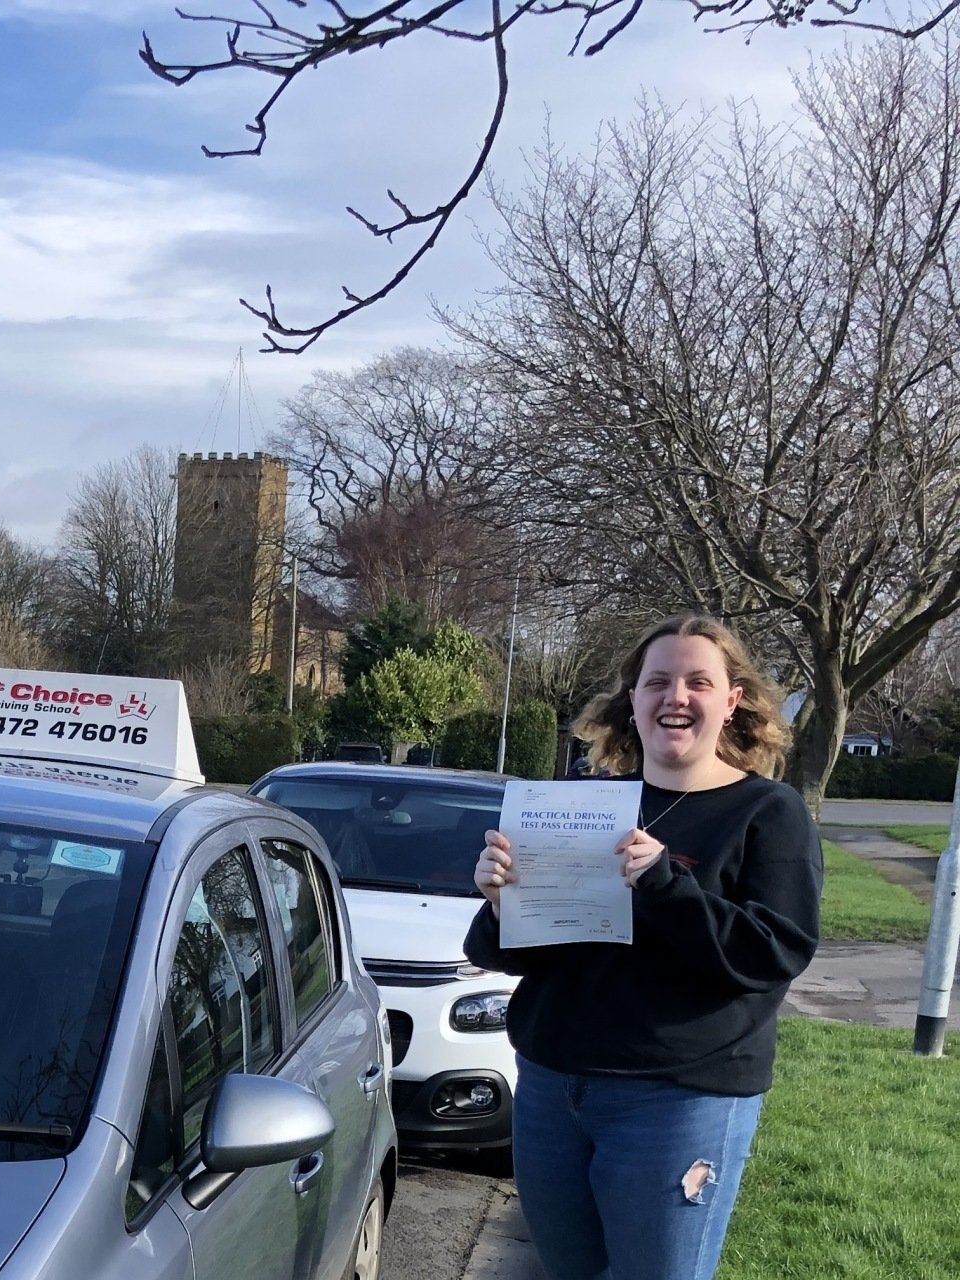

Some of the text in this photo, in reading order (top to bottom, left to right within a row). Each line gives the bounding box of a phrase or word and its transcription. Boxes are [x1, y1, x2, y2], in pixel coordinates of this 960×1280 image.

[10, 683, 113, 706] Choice
[48, 721, 149, 745] 476016
[521, 811, 616, 821] PRACTICAL DRIVING
[520, 821, 616, 831] TEST PASS CERTIFICATE
